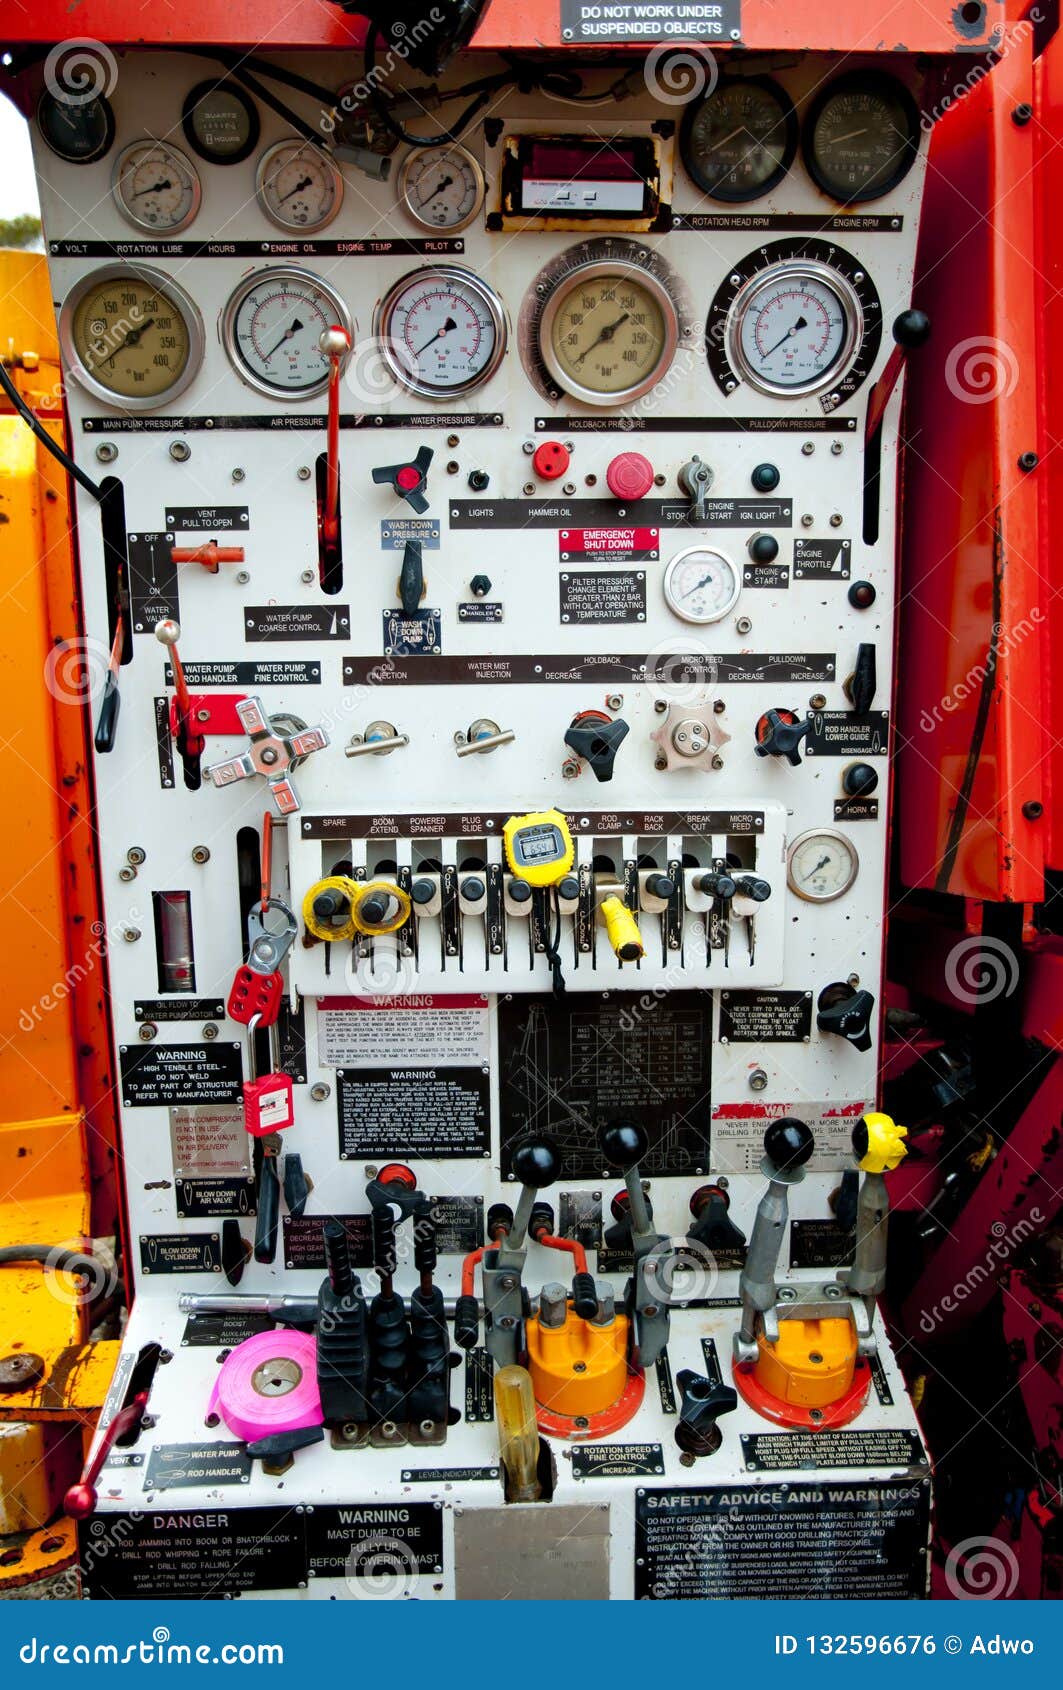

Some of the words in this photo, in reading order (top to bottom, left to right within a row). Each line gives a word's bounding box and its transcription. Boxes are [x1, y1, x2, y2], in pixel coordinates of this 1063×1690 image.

[581, 7, 600, 18] DO
[604, 7, 631, 18] NOT
[633, 6, 673, 18] WORK
[677, 6, 722, 17] UNDER
[581, 23, 661, 34] SUSPENDED
[664, 22, 722, 34] OBJECTS
[692, 218, 729, 226] ROTATION
[731, 218, 750, 226] HEAD
[753, 218, 769, 226] RPM
[834, 219, 859, 227] ENGINE
[862, 219, 879, 227] RPM
[65, 245, 88, 253] VOLT
[117, 245, 158, 253] ROTATION
[162, 245, 183, 253] LUBE
[271, 244, 298, 253] ENGINE
[304, 244, 316, 252] OIL
[337, 243, 366, 251] ENGINE
[371, 243, 391, 251] TEMP
[425, 242, 448, 251] PILOT
[122, 293, 137, 305] 200
[143, 301, 158, 313] 250
[156, 318, 171, 329] 300
[160, 336, 175, 348] 350
[153, 355, 168, 366] 400
[103, 421, 120, 429] MAIN
[145, 420, 184, 428] PRESSURE
[583, 530, 635, 539] EMERGENCY
[608, 540, 633, 548] DOWN
[259, 624, 288, 632] COARSE
[284, 664, 305, 672] PUMP
[201, 674, 237, 682] HANDLER
[255, 674, 271, 682] FINE
[645, 815, 663, 823] RACK
[598, 822, 621, 830] CLAMP
[645, 823, 663, 831] BACK
[373, 995, 433, 1006] WARNING
[157, 1051, 206, 1060] WARNING
[206, 1468, 241, 1476] HANDLER
[647, 1496, 713, 1508] SAFETY
[719, 1493, 782, 1504] ADVICE
[788, 1492, 823, 1503] AND
[829, 1488, 920, 1501] WARNINGS
[339, 1510, 409, 1523] WARNING
[154, 1515, 229, 1529] DANGER
[328, 1530, 356, 1539] MAST
[358, 1529, 388, 1538] DUMP
[391, 1529, 404, 1537] TO
[408, 1528, 421, 1536] BE
[350, 1543, 382, 1552] FULLY
[385, 1543, 399, 1551] UP
[310, 1557, 351, 1567] BEFORE
[354, 1556, 409, 1566] LOWERING
[412, 1554, 439, 1564] MAST
